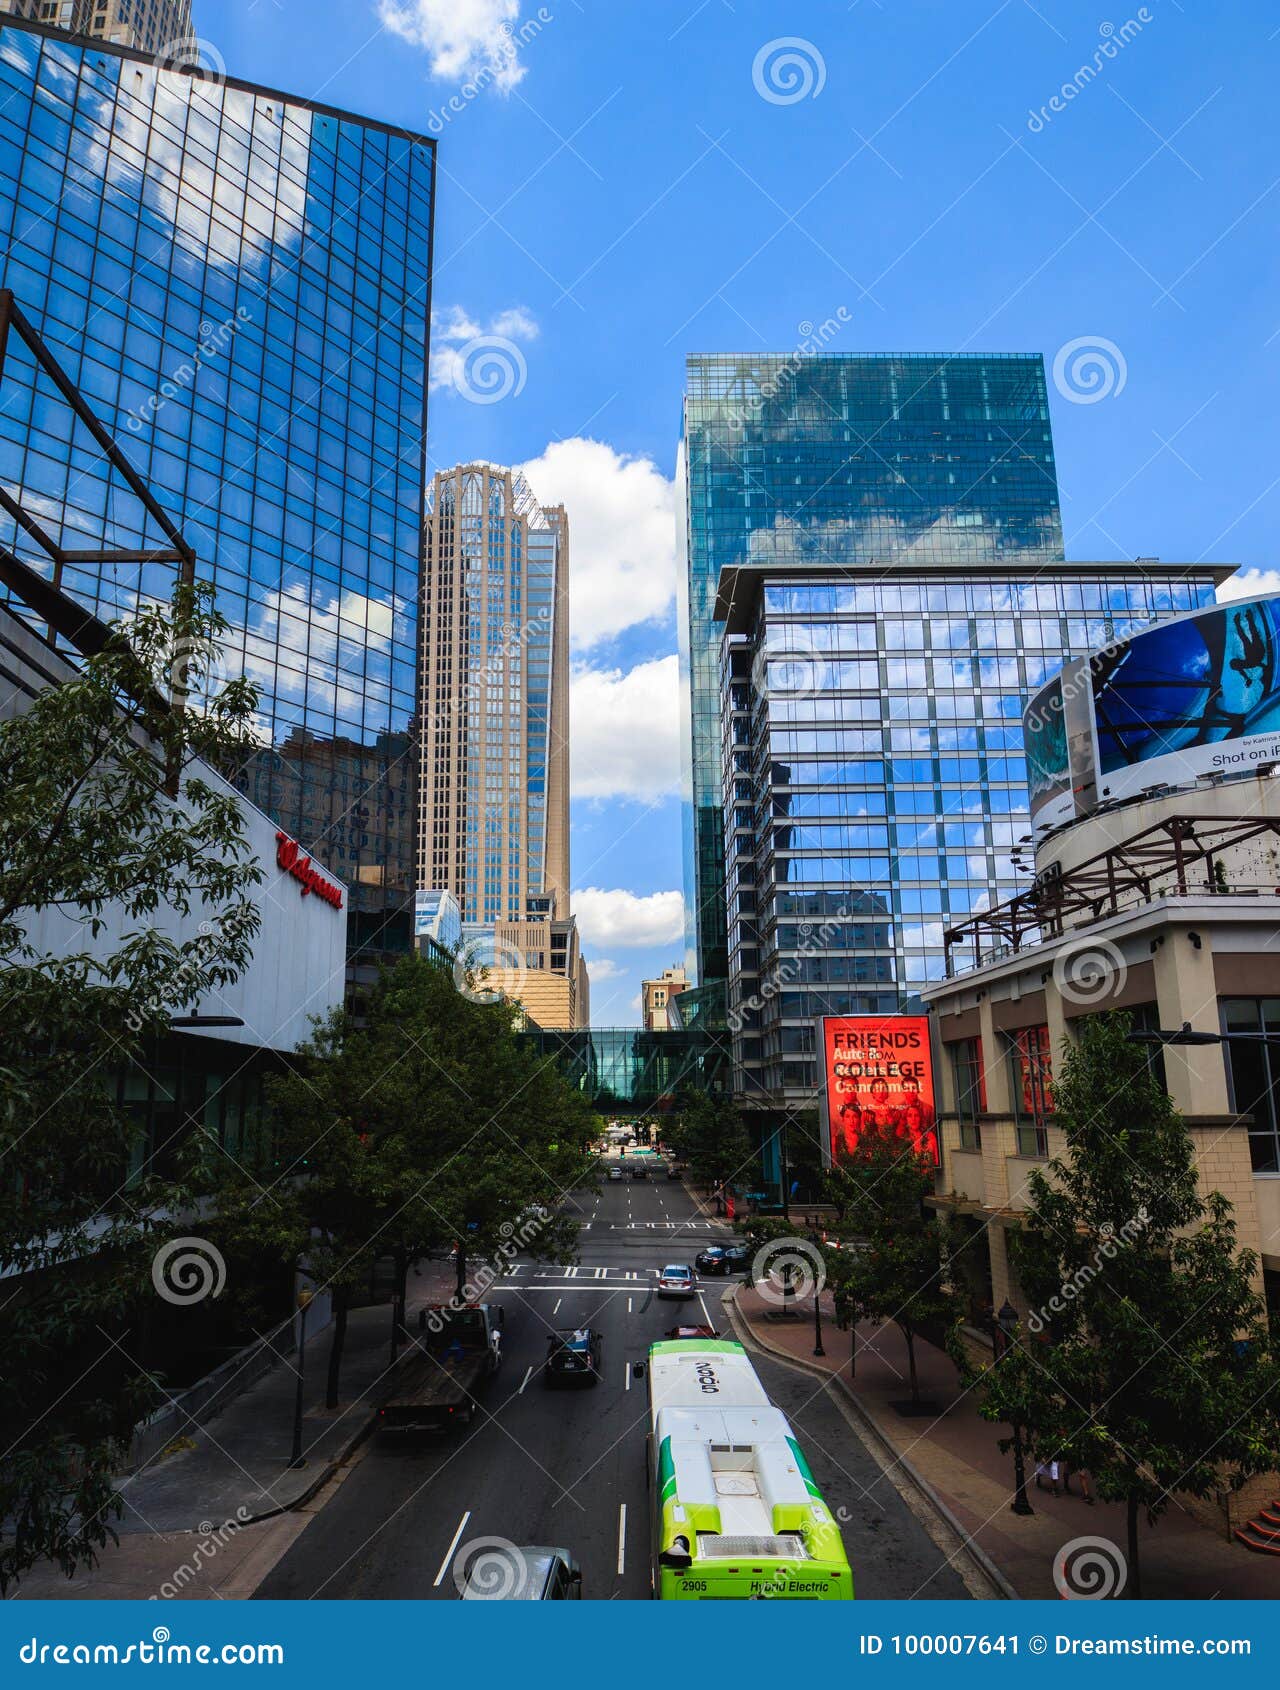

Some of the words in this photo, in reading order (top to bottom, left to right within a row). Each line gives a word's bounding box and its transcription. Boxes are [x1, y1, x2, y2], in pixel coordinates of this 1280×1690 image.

[1212, 752, 1246, 766] Shot
[1249, 749, 1267, 760] on
[834, 1032, 921, 1049] FRIENDS
[833, 1048, 864, 1060] Auto
[834, 1061, 926, 1078] COLLEGE
[681, 1581, 707, 1592] 2905
[750, 1581, 786, 1595] Hybrid
[788, 1581, 829, 1592] Electric
